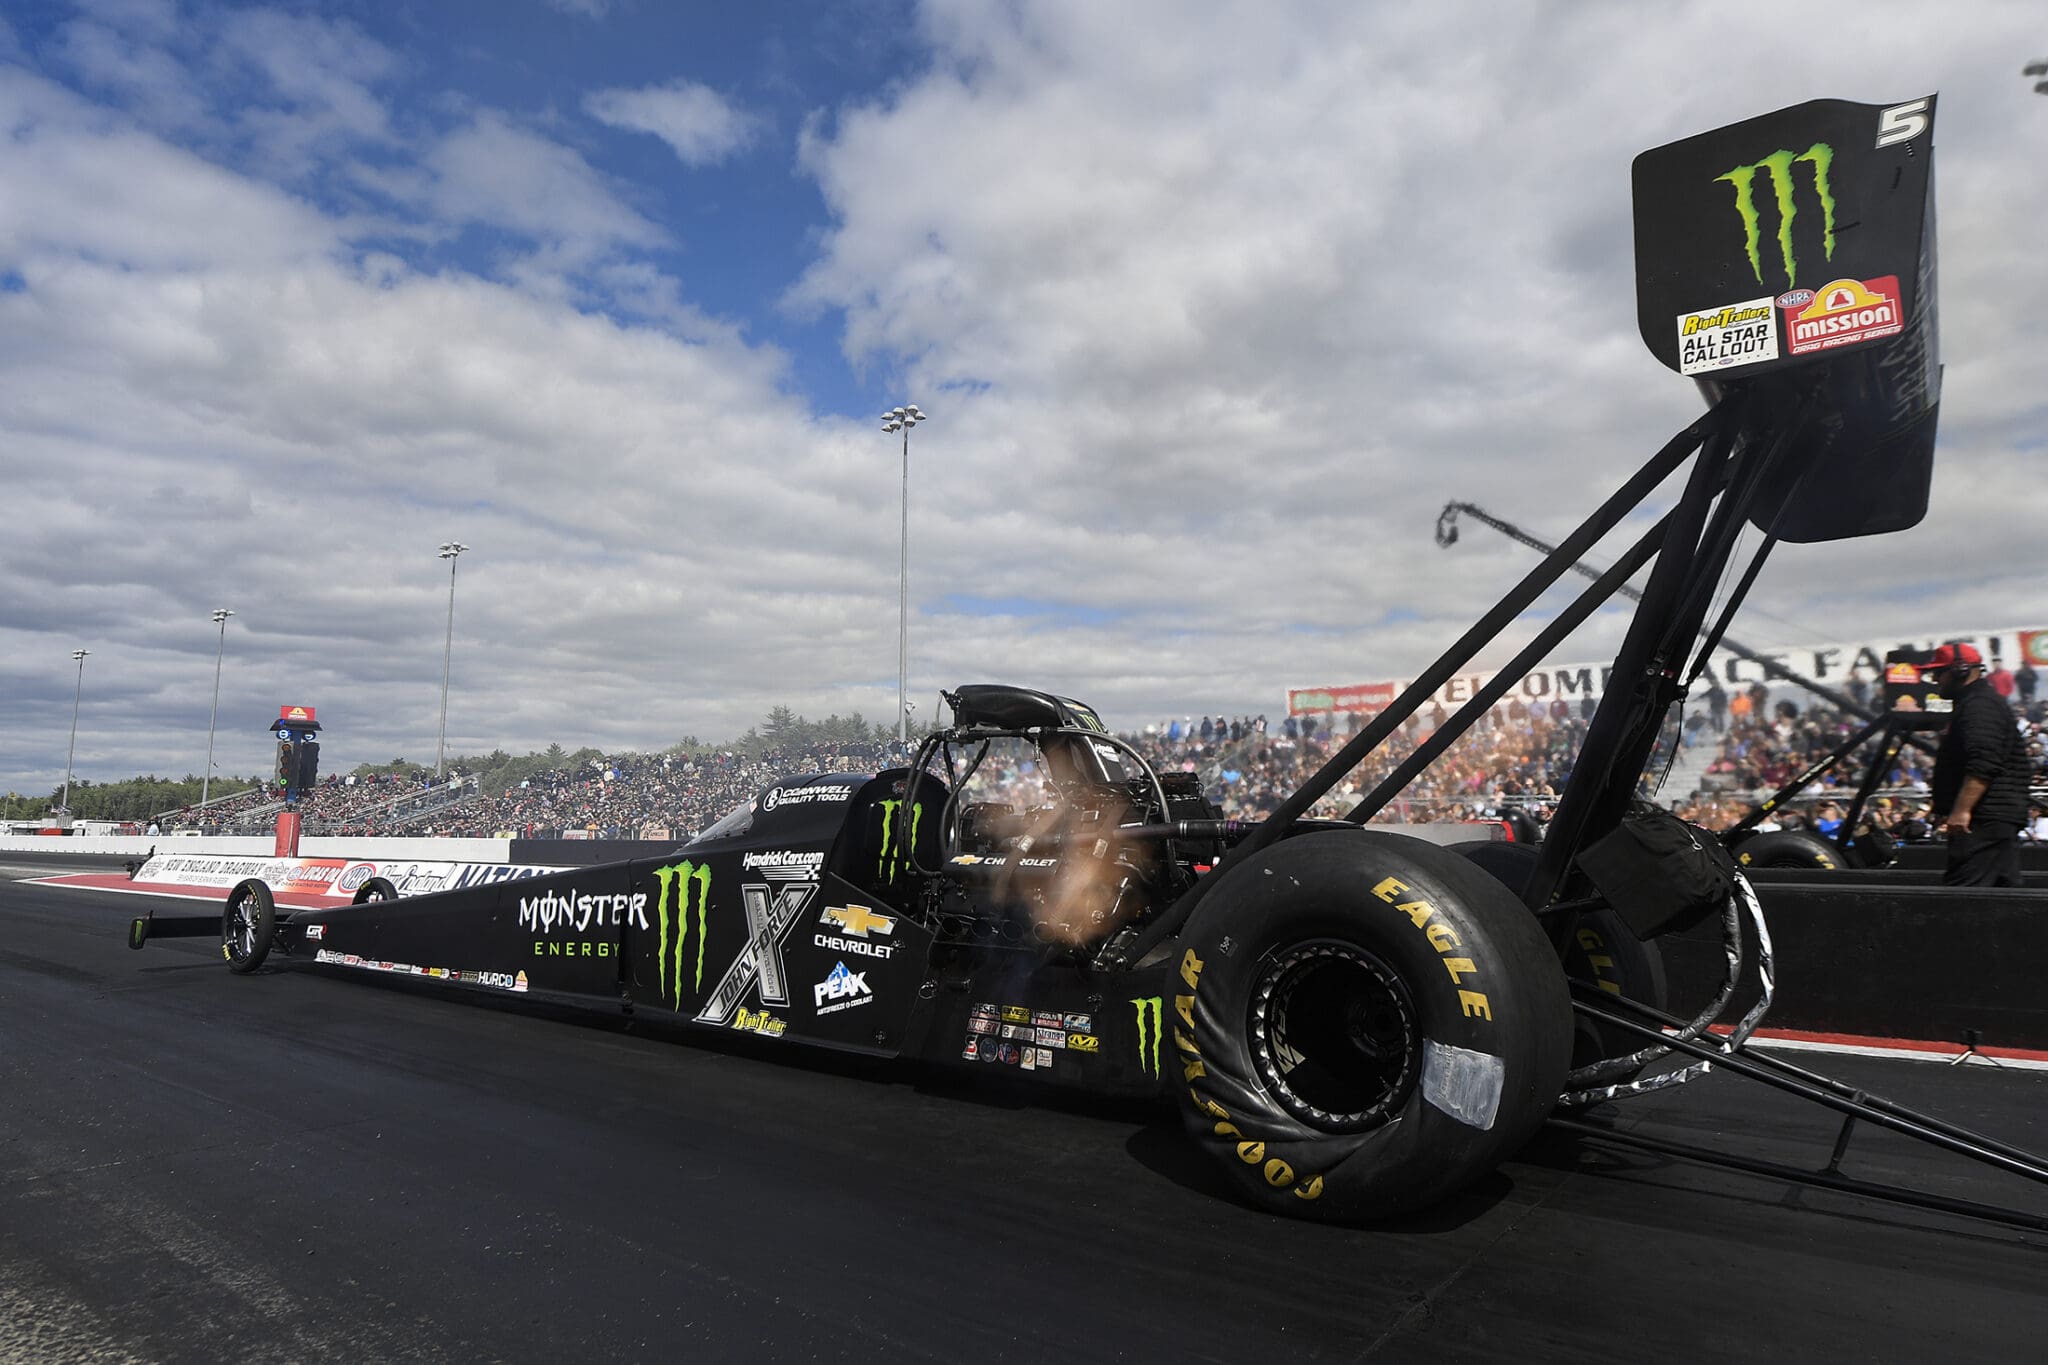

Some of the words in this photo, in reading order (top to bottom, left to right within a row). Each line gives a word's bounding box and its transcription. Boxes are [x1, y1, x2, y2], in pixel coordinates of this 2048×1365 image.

[1875, 98, 1929, 148] 5
[1780, 292, 1810, 305] NHRA
[1684, 335, 1717, 352] ALL
[1722, 324, 1768, 344] STAR
[1792, 341, 1822, 354] DRAG
[1822, 334, 1862, 348] RACING
[1863, 325, 1903, 339] SERIES
[1684, 337, 1769, 364] CALLOUT
[779, 795, 815, 805] QUALITY
[816, 793, 849, 802] TOOLS
[783, 785, 852, 797] CORNWELL
[163, 859, 186, 871] NEW
[185, 860, 220, 874] ENGLAND
[218, 861, 266, 876] DRAGWAY
[301, 865, 329, 881] LUCAS
[342, 866, 373, 889] NHRA
[518, 888, 650, 935] MONSTER
[534, 941, 620, 957] ENERGY
[718, 956, 757, 1014] JOHN
[752, 892, 796, 964] FORCE
[814, 935, 893, 959] CHEVROLET
[1370, 876, 1492, 1022] EAGLE
[477, 971, 513, 988] HURCO
[814, 971, 873, 1007] PEAK
